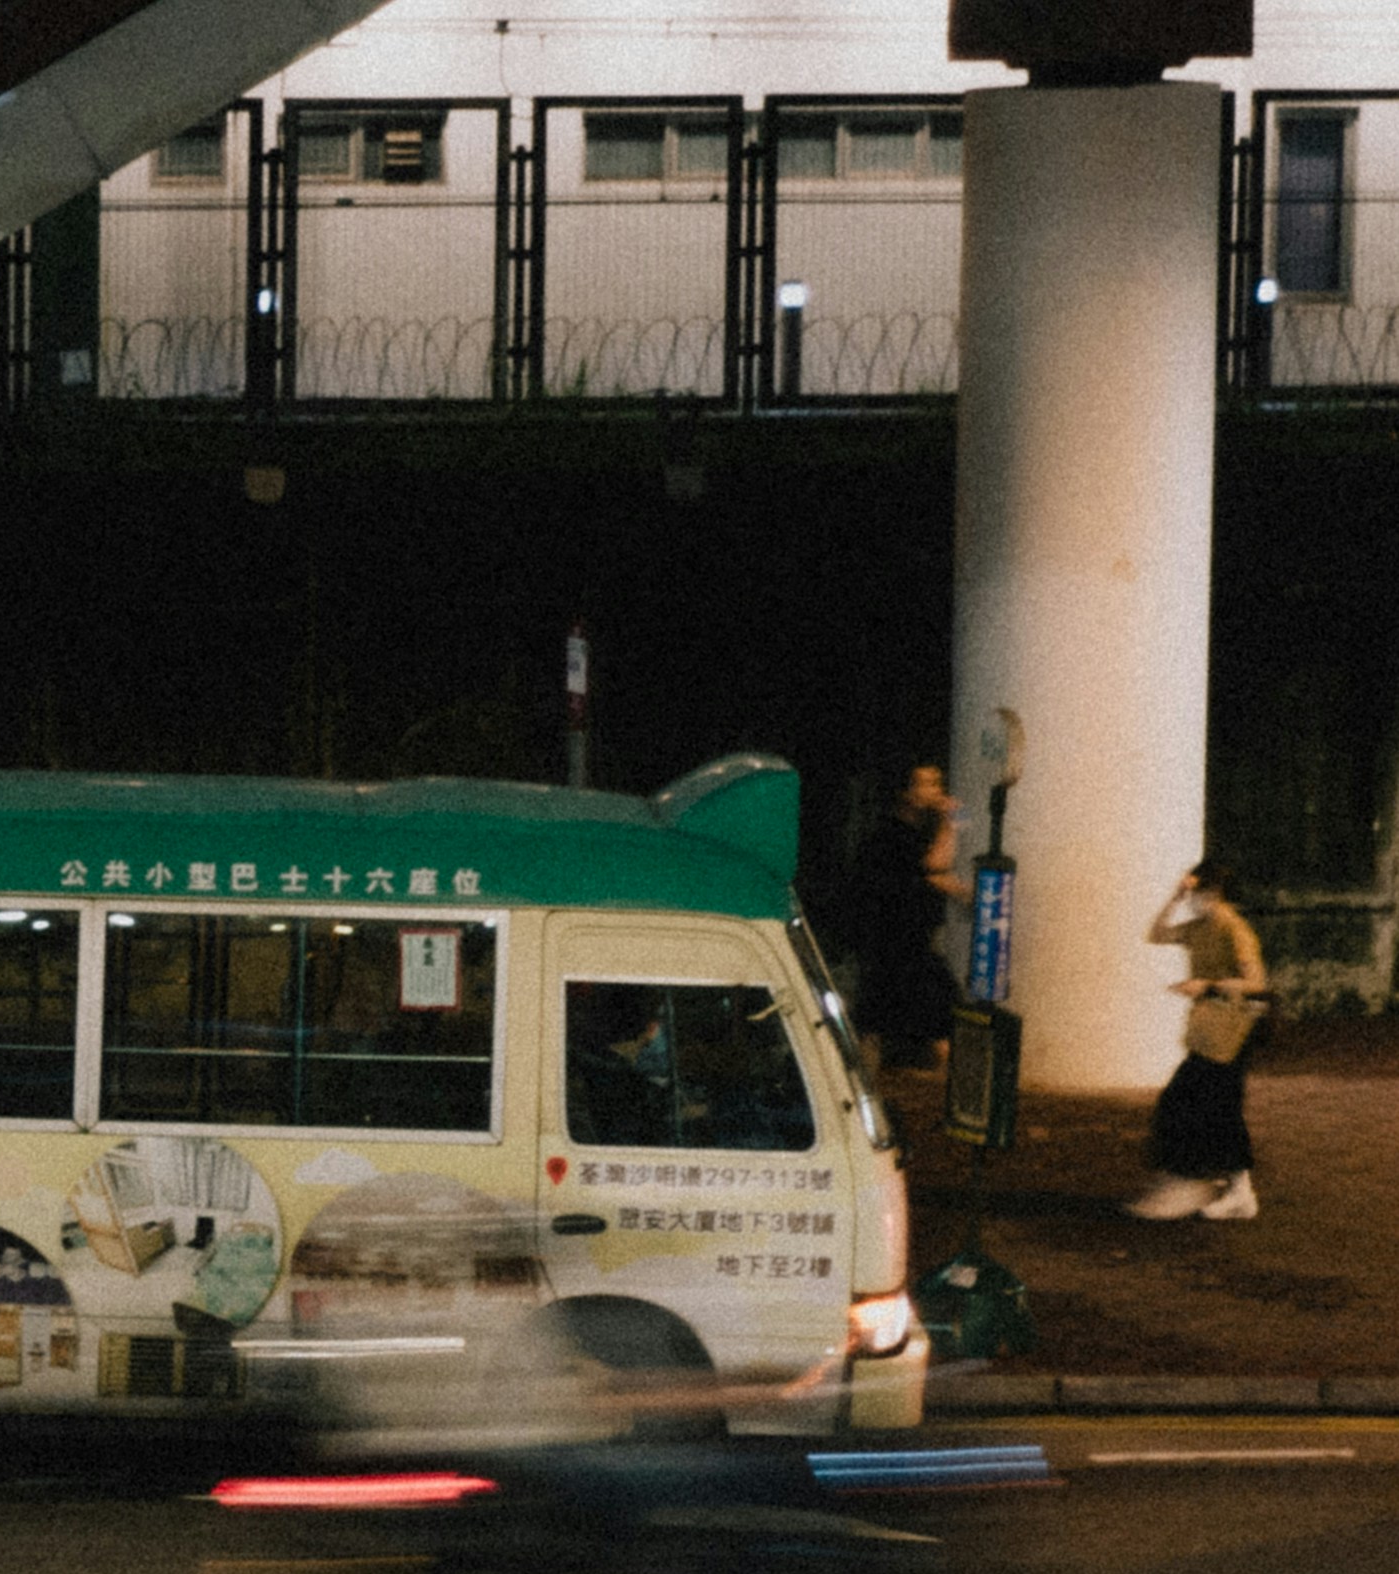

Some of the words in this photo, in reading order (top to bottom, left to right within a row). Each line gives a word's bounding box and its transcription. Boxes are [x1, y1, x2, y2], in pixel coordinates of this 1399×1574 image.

[59, 860, 482, 896] 公共小型巴士十六座位
[715, 1254, 833, 1279] 地下至2樓
